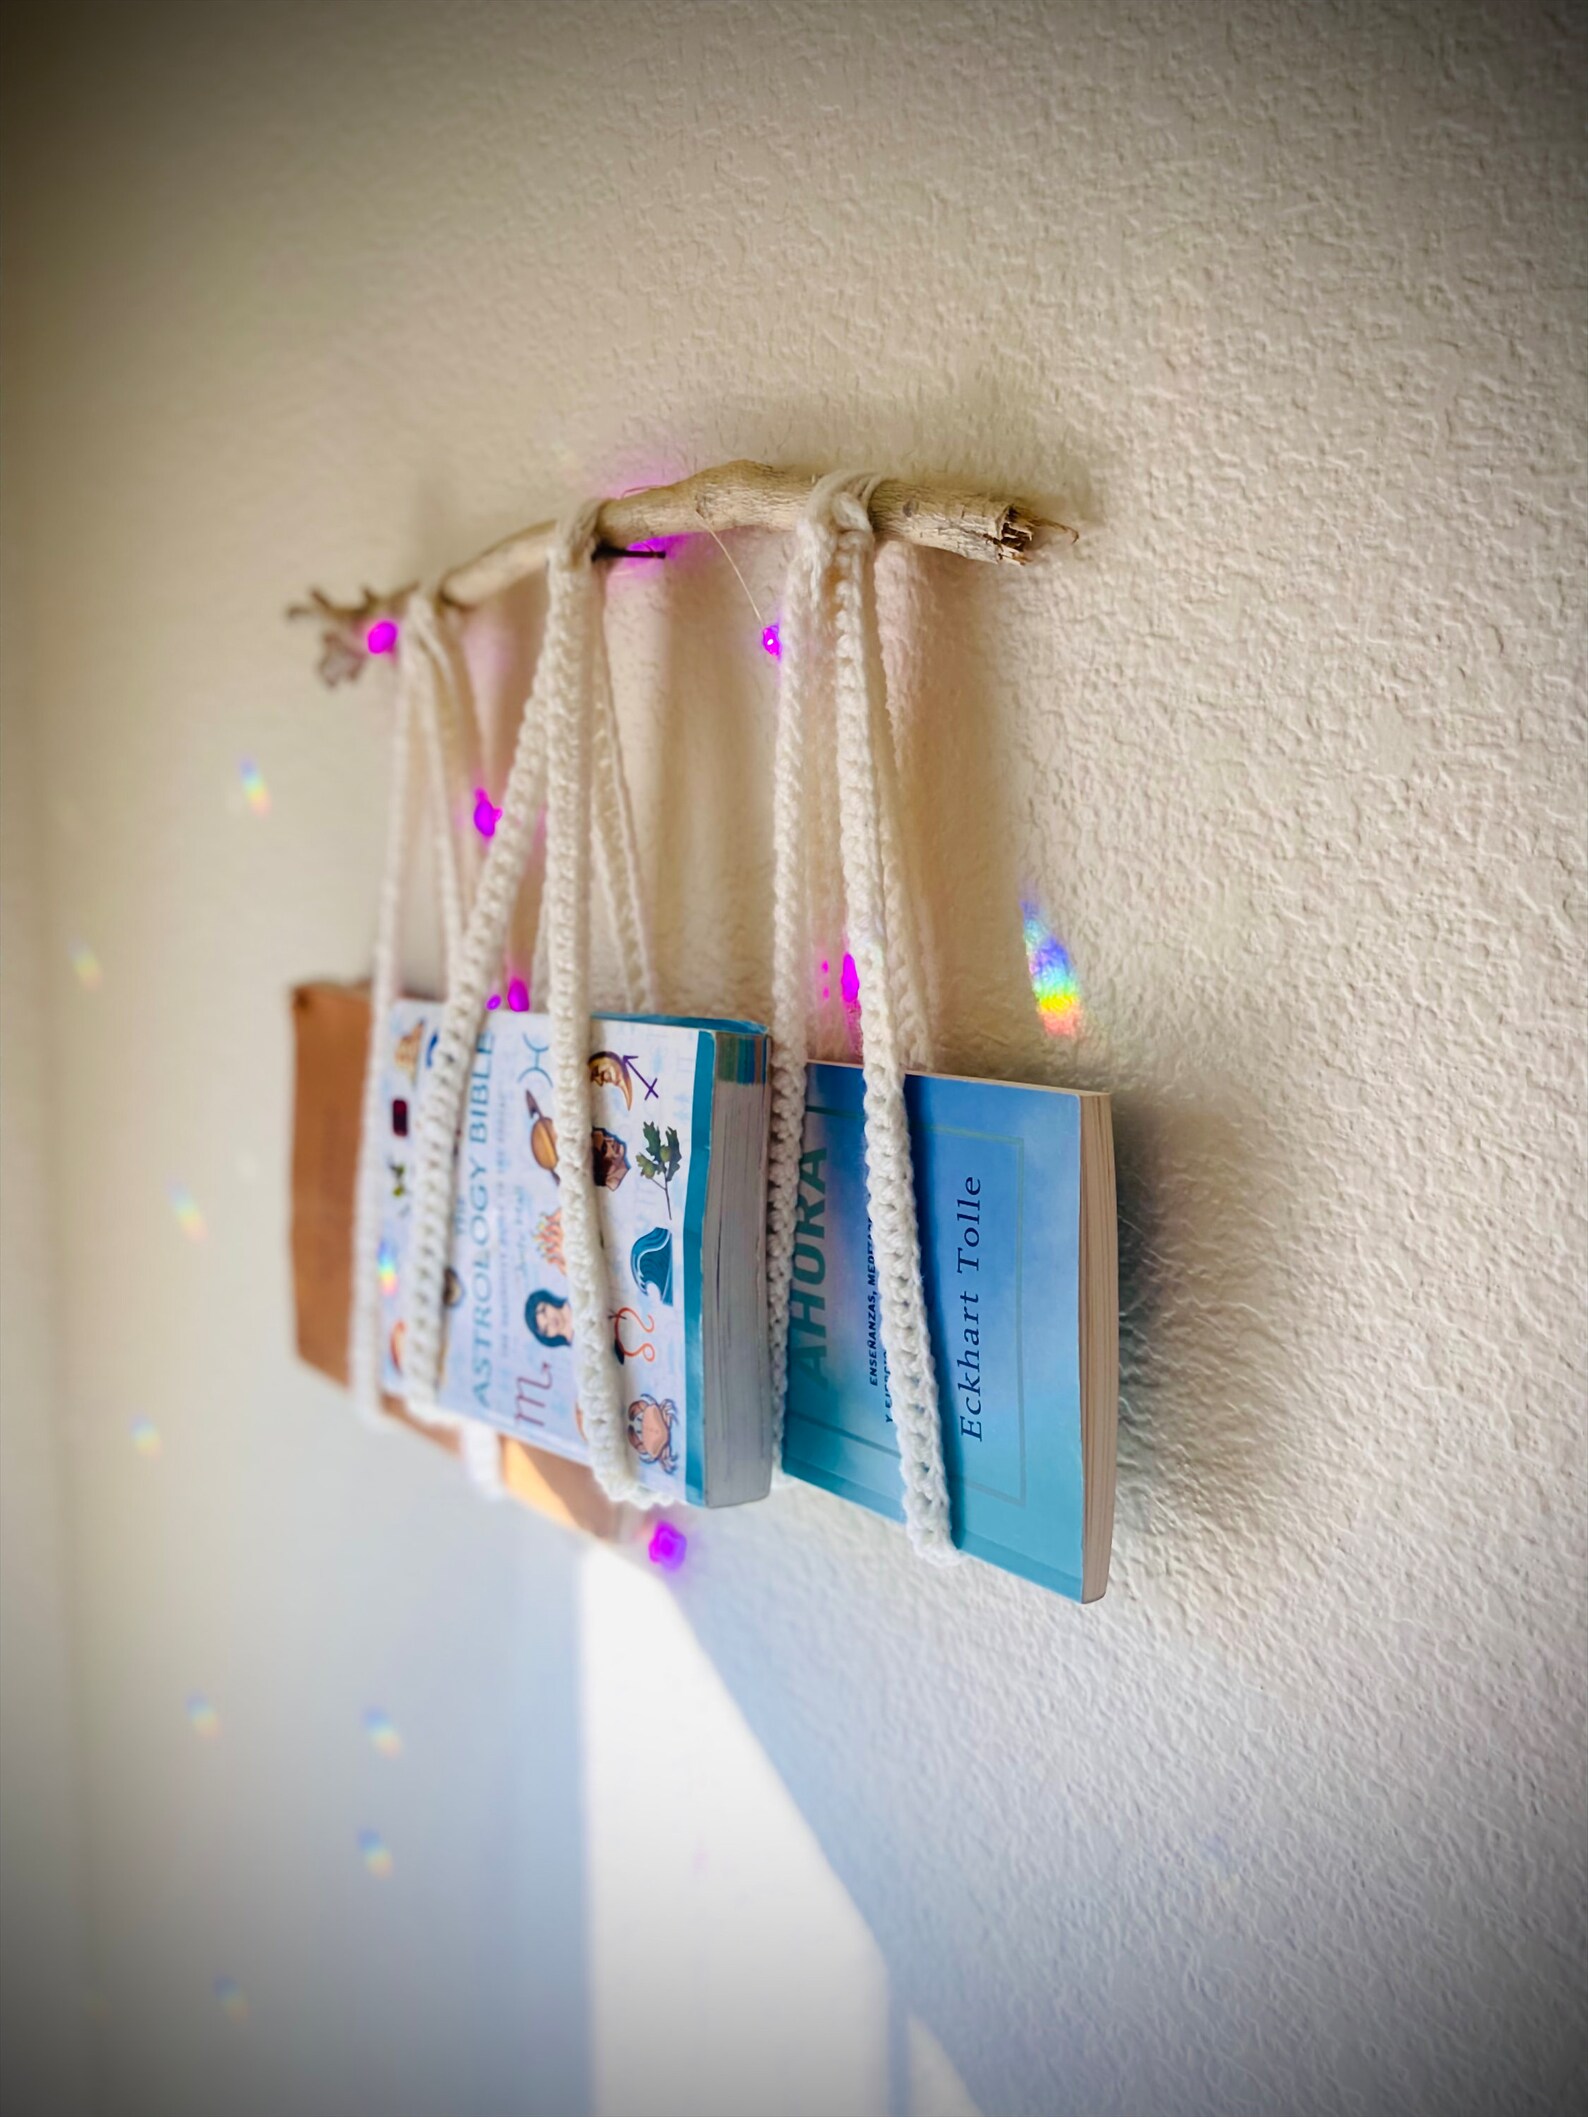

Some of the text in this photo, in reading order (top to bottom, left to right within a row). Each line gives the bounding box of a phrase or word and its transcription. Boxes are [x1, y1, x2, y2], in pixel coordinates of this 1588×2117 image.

[468, 1030, 495, 1407] ASTROLOGY BIBLE
[788, 1146, 828, 1390] AHORA
[867, 1291, 878, 1387] ENSEÑANZAS,
[956, 1176, 982, 1442] Eckhart Tolle
